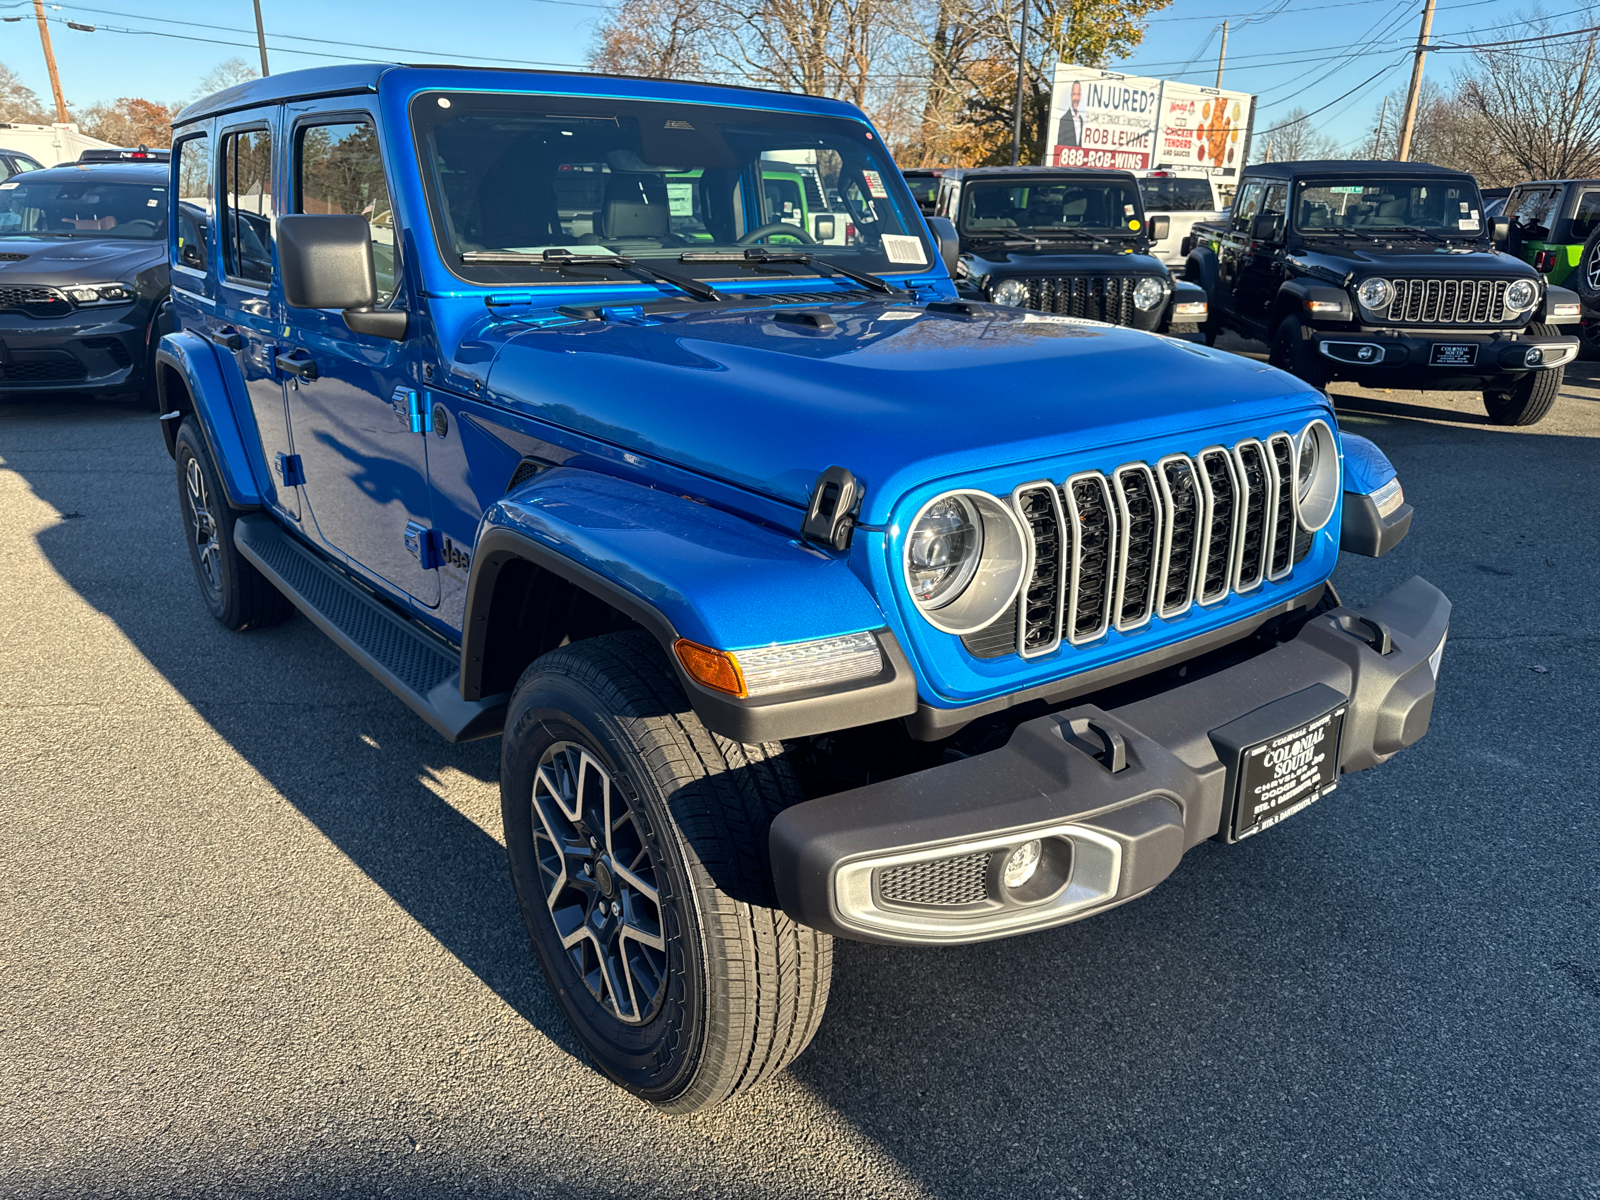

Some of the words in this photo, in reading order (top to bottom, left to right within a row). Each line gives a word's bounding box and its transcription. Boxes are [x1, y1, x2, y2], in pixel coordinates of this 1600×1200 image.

[1086, 82, 1155, 115] INJURED?
[1084, 127, 1109, 145] ROB
[1111, 129, 1150, 149] LEVINE
[1164, 138, 1192, 150] TENDERS
[1165, 126, 1194, 139] CHICKEN
[1060, 147, 1143, 170] 888-ROB-WINS
[440, 537, 471, 574] Jee
[1263, 727, 1325, 768] COLONIAL
[1273, 745, 1315, 779] SOUTH
[1254, 764, 1308, 794] CHRYSLER
[1261, 779, 1297, 801] DODGE
[1270, 799, 1277, 808] 6
